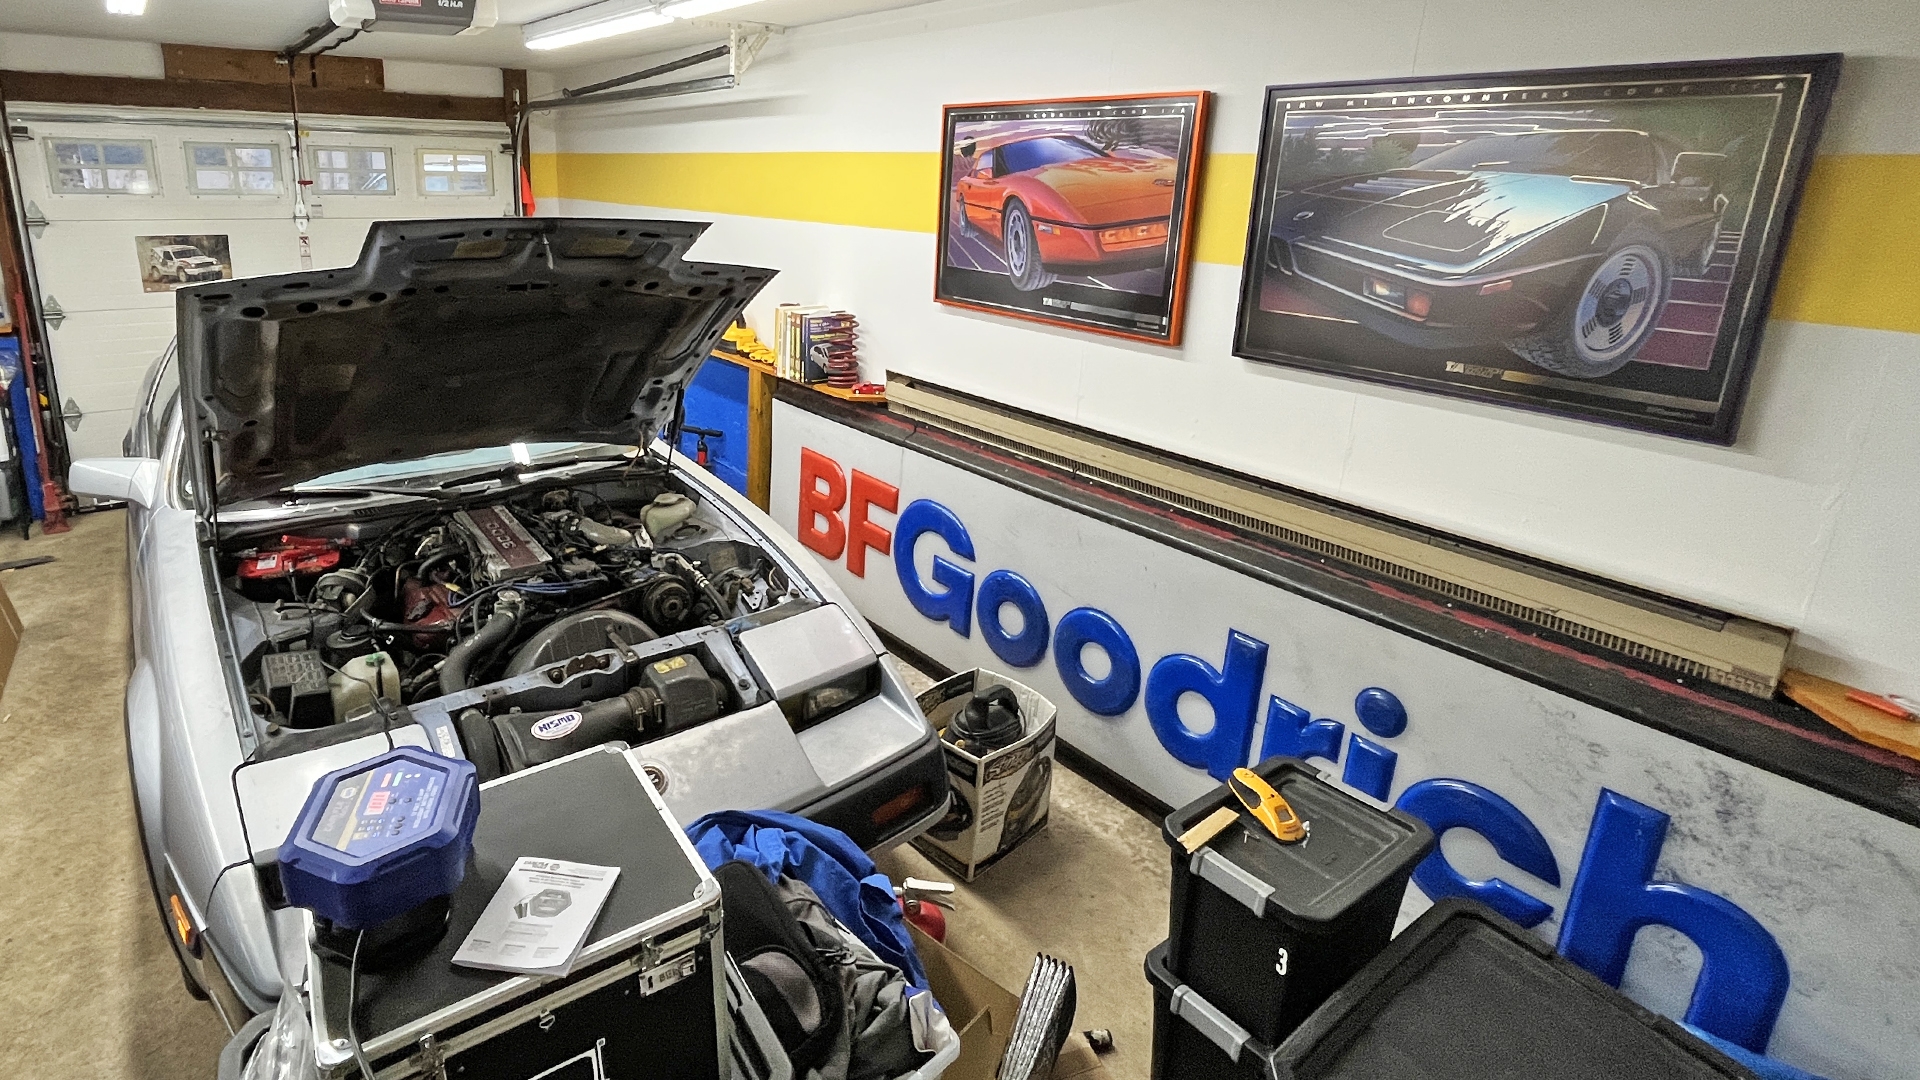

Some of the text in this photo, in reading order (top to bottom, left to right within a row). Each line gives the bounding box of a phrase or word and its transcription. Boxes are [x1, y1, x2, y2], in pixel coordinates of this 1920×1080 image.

[1286, 101, 1323, 109] BMW
[1391, 91, 1569, 105] ENCOUNTERS
[538, 714, 576, 733] NISMO
[798, 446, 1791, 1056] BFGoodrich
[1275, 947, 1288, 976] 3
